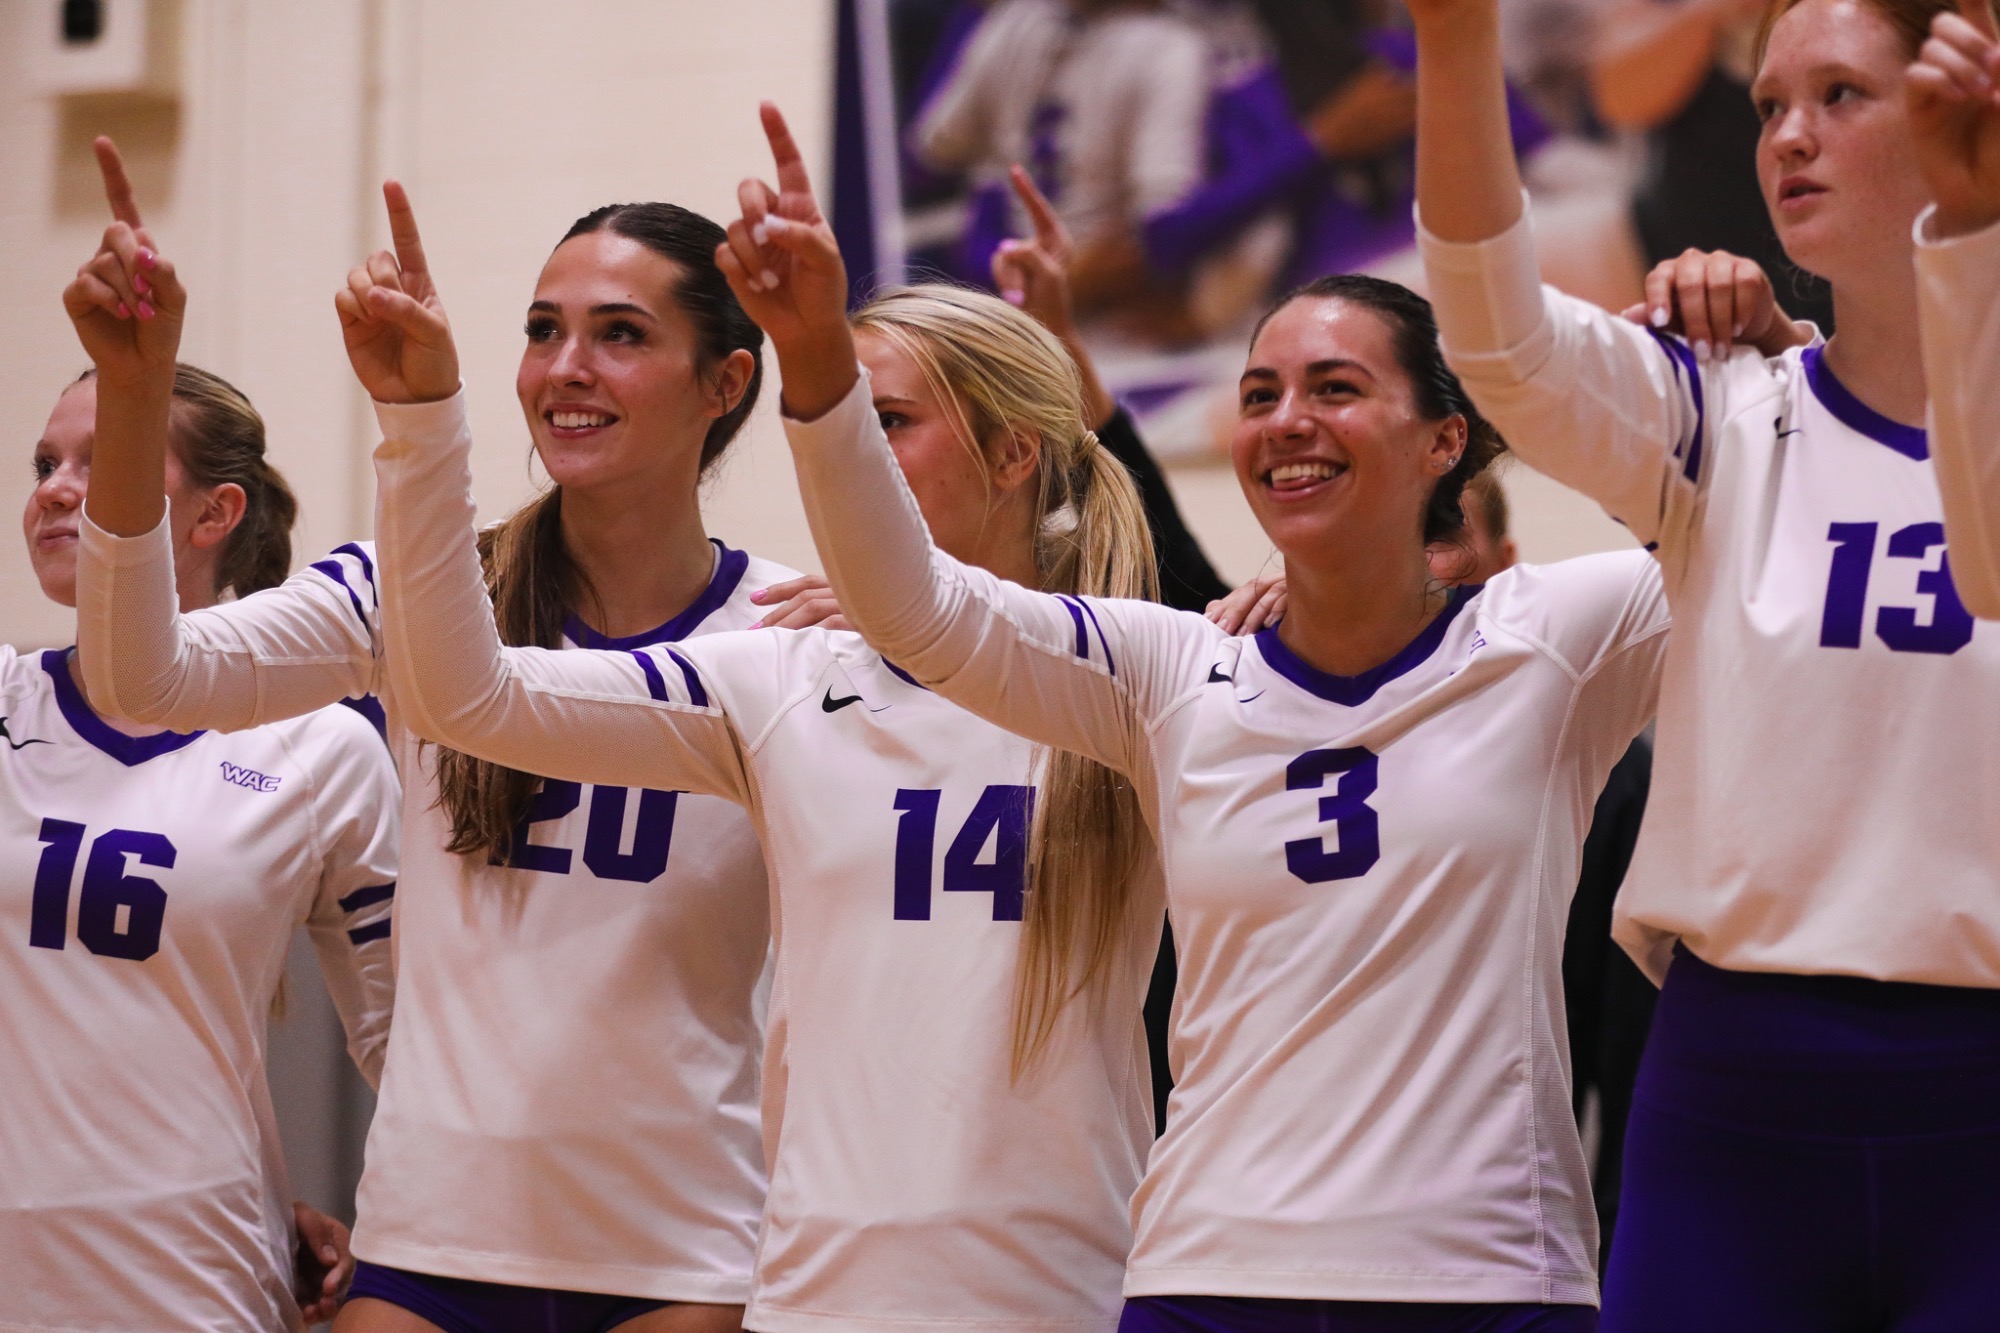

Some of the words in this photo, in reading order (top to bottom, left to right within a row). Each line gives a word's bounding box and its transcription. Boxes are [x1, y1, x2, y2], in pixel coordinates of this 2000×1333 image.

[1819, 521, 1974, 655] 13
[220, 761, 281, 792] WAC
[488, 779, 677, 883] 20
[1285, 745, 1380, 884] 3
[29, 817, 177, 961] 16
[893, 785, 1037, 922] 14
